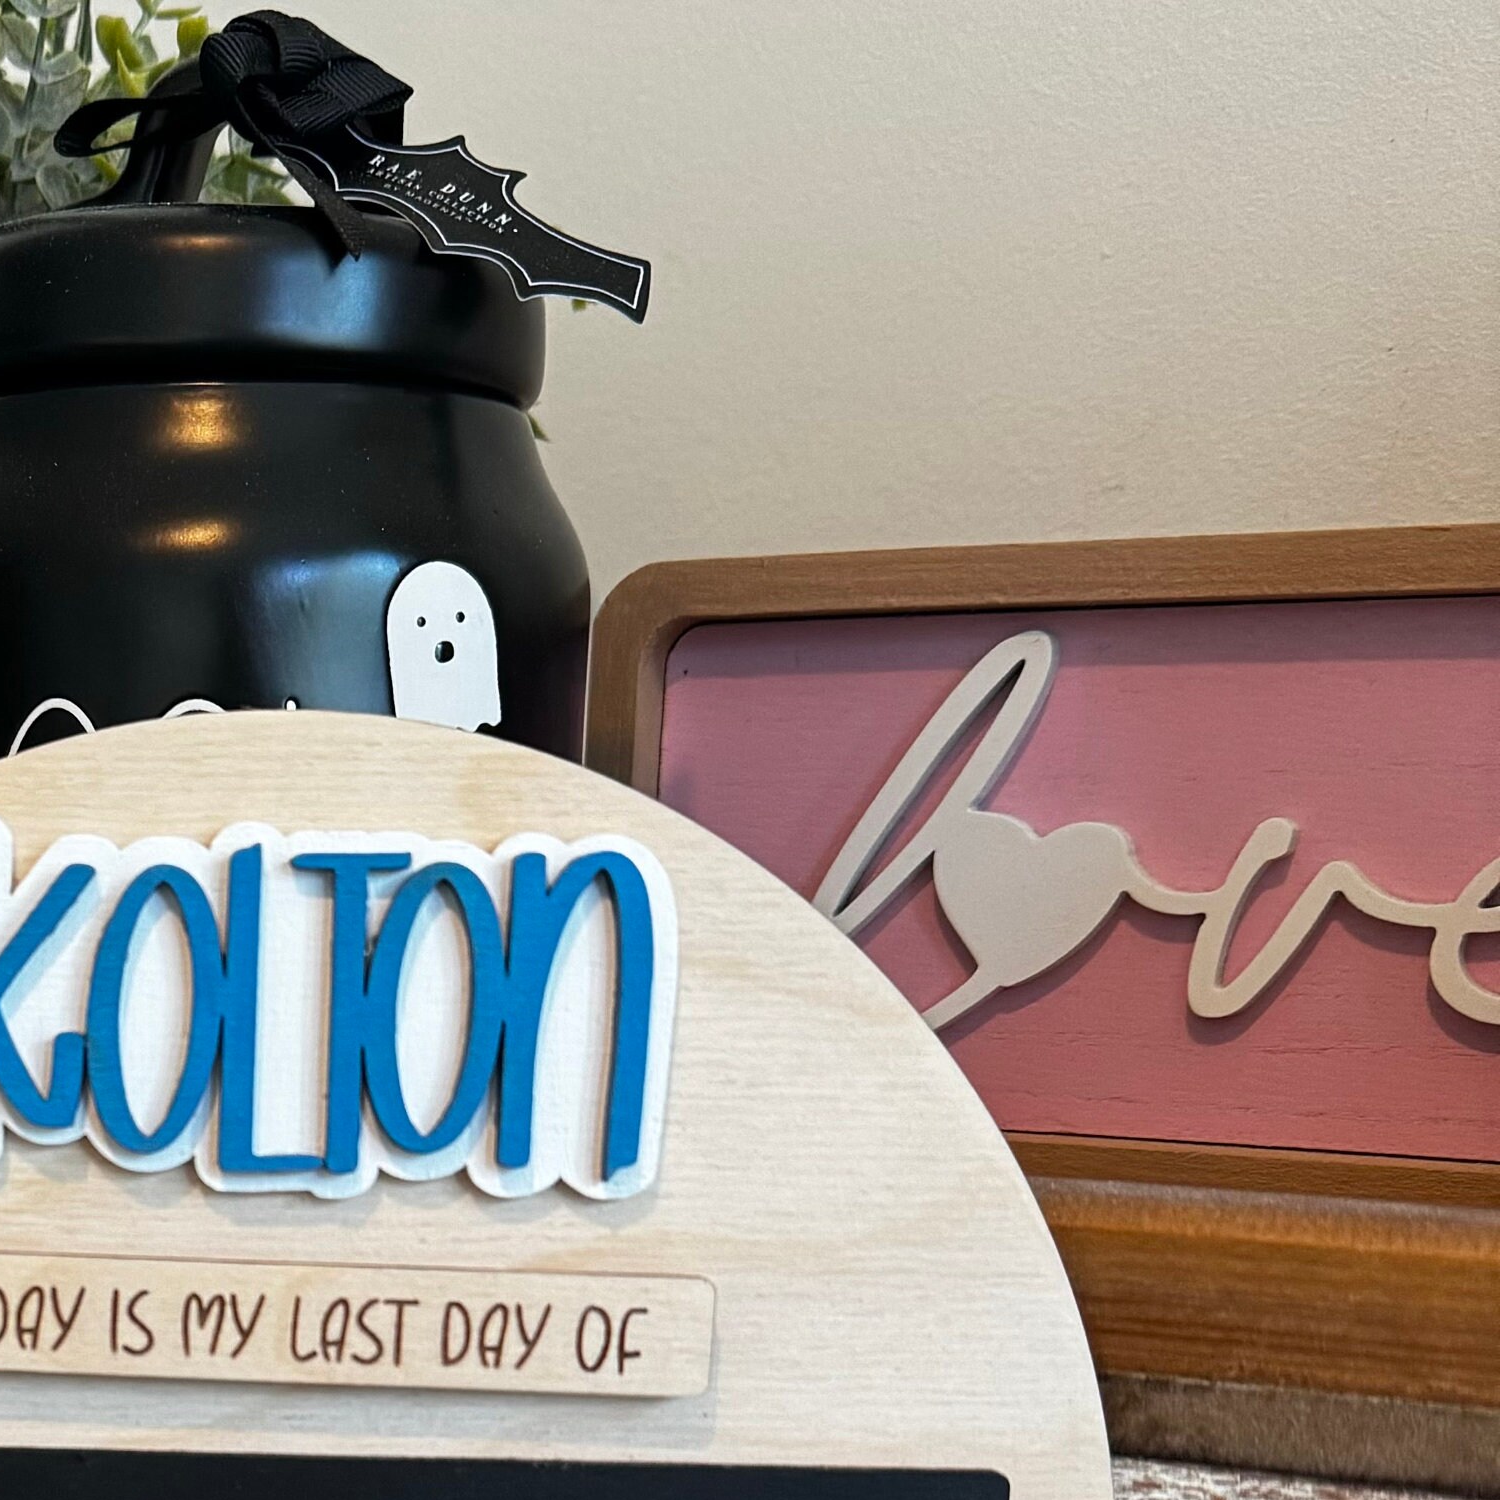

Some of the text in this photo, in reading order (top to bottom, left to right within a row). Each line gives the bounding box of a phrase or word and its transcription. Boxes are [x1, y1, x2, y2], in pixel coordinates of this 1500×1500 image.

[367, 167, 505, 235] ARTISAN COLLECTION
[368, 154, 422, 180] RAE
[109, 1287, 155, 1358] IS
[181, 1291, 266, 1360] MY
[289, 1294, 421, 1367] LAST
[440, 1301, 553, 1371] DAY
[575, 1304, 650, 1375] OF
